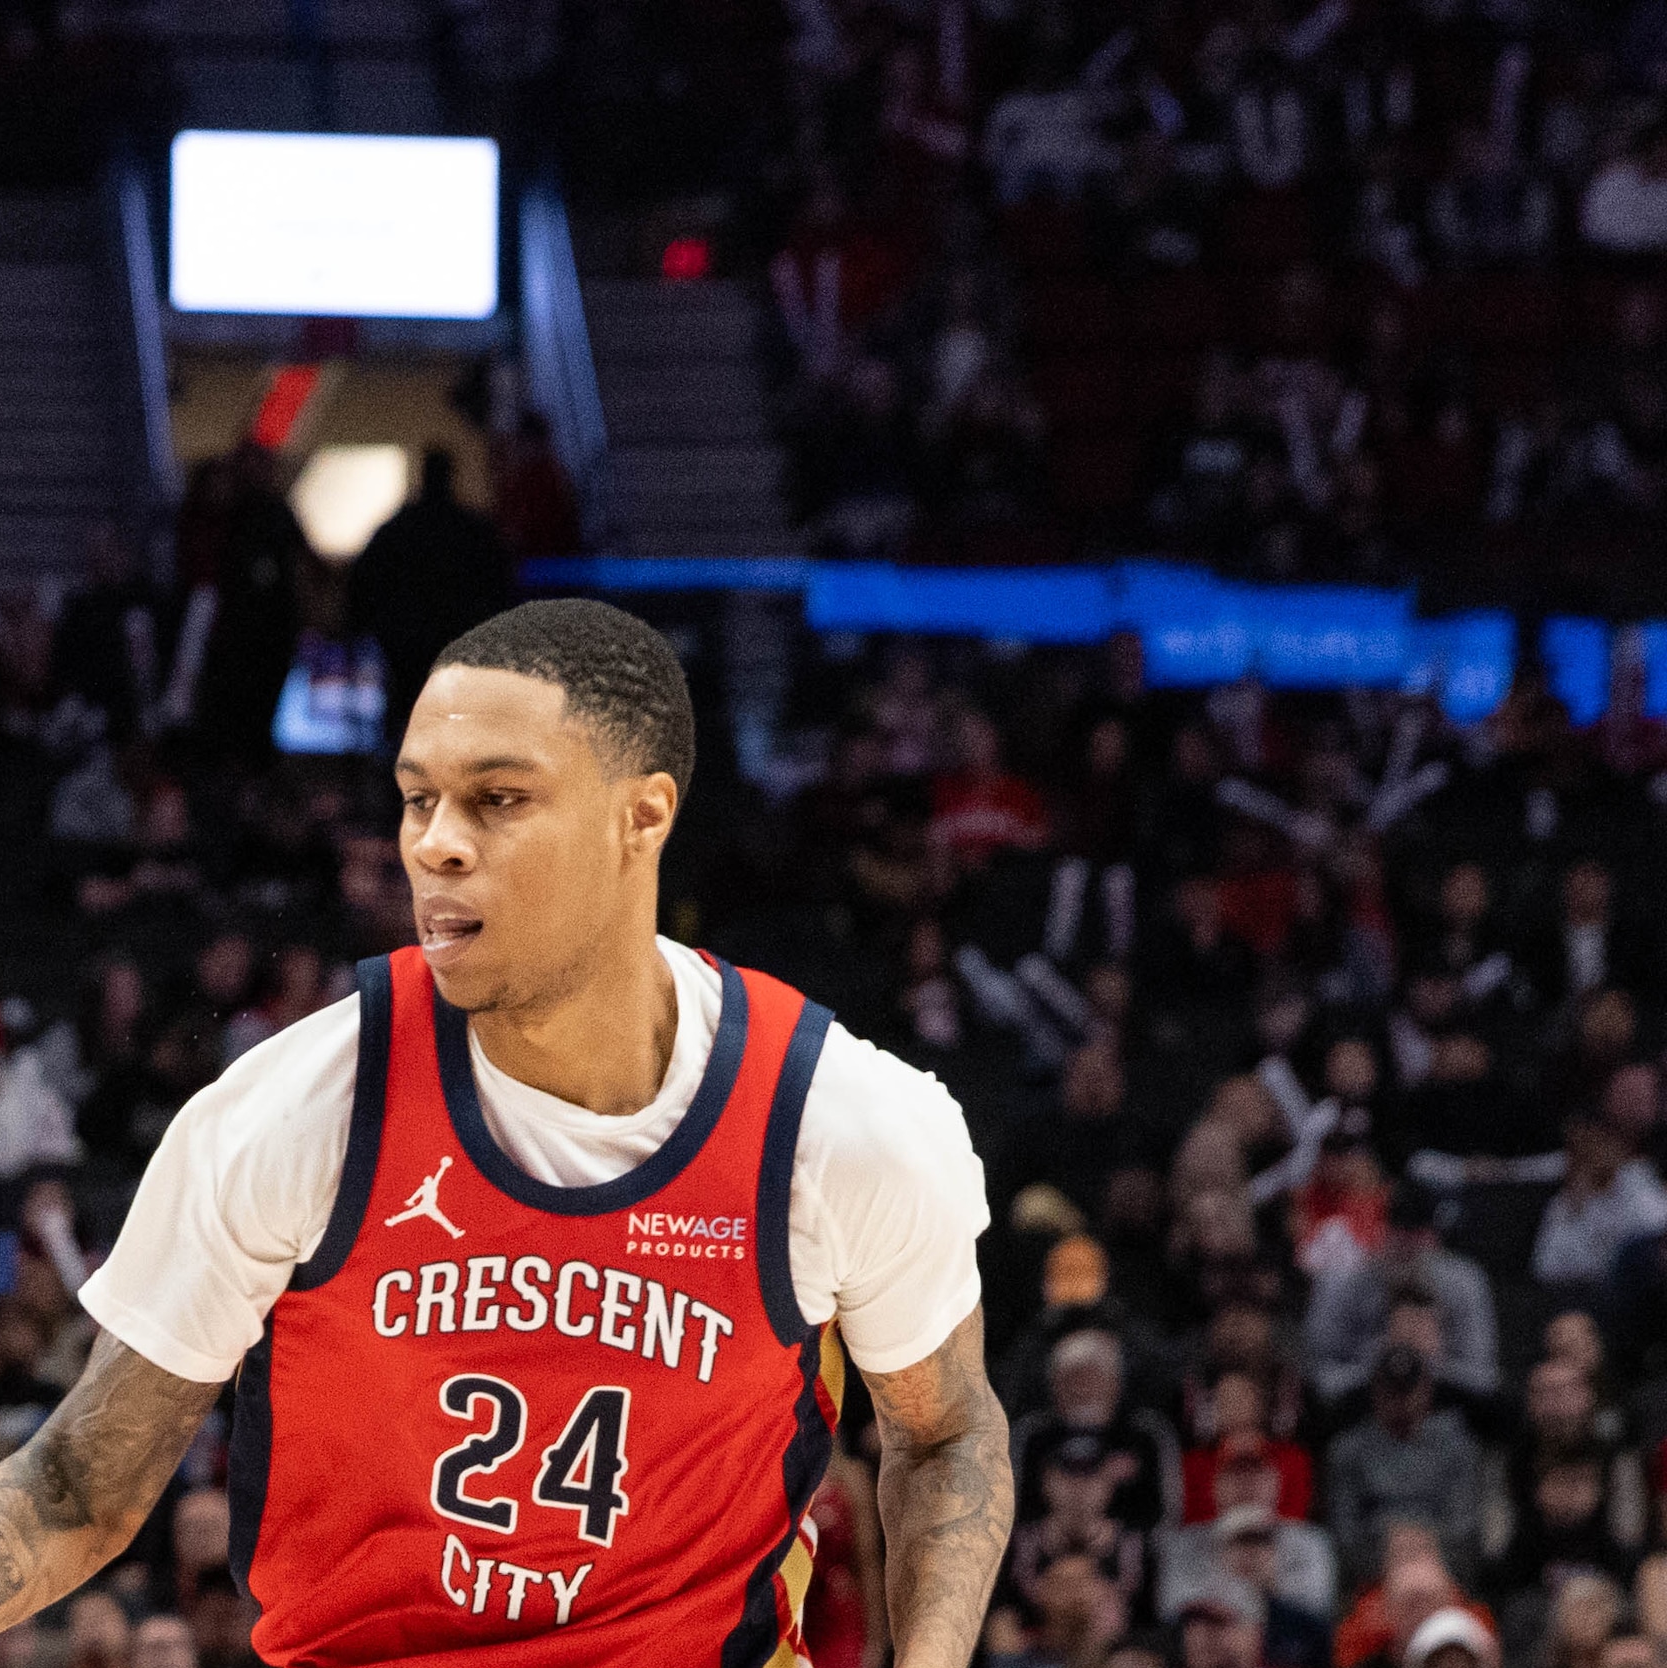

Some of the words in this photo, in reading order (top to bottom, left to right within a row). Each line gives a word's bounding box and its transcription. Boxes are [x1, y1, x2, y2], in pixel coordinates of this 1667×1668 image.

[626, 1240, 746, 1261] PRODUCTS
[371, 1254, 735, 1384] CRESCENT
[430, 1372, 631, 1549] 24
[440, 1533, 595, 1626] CITY
